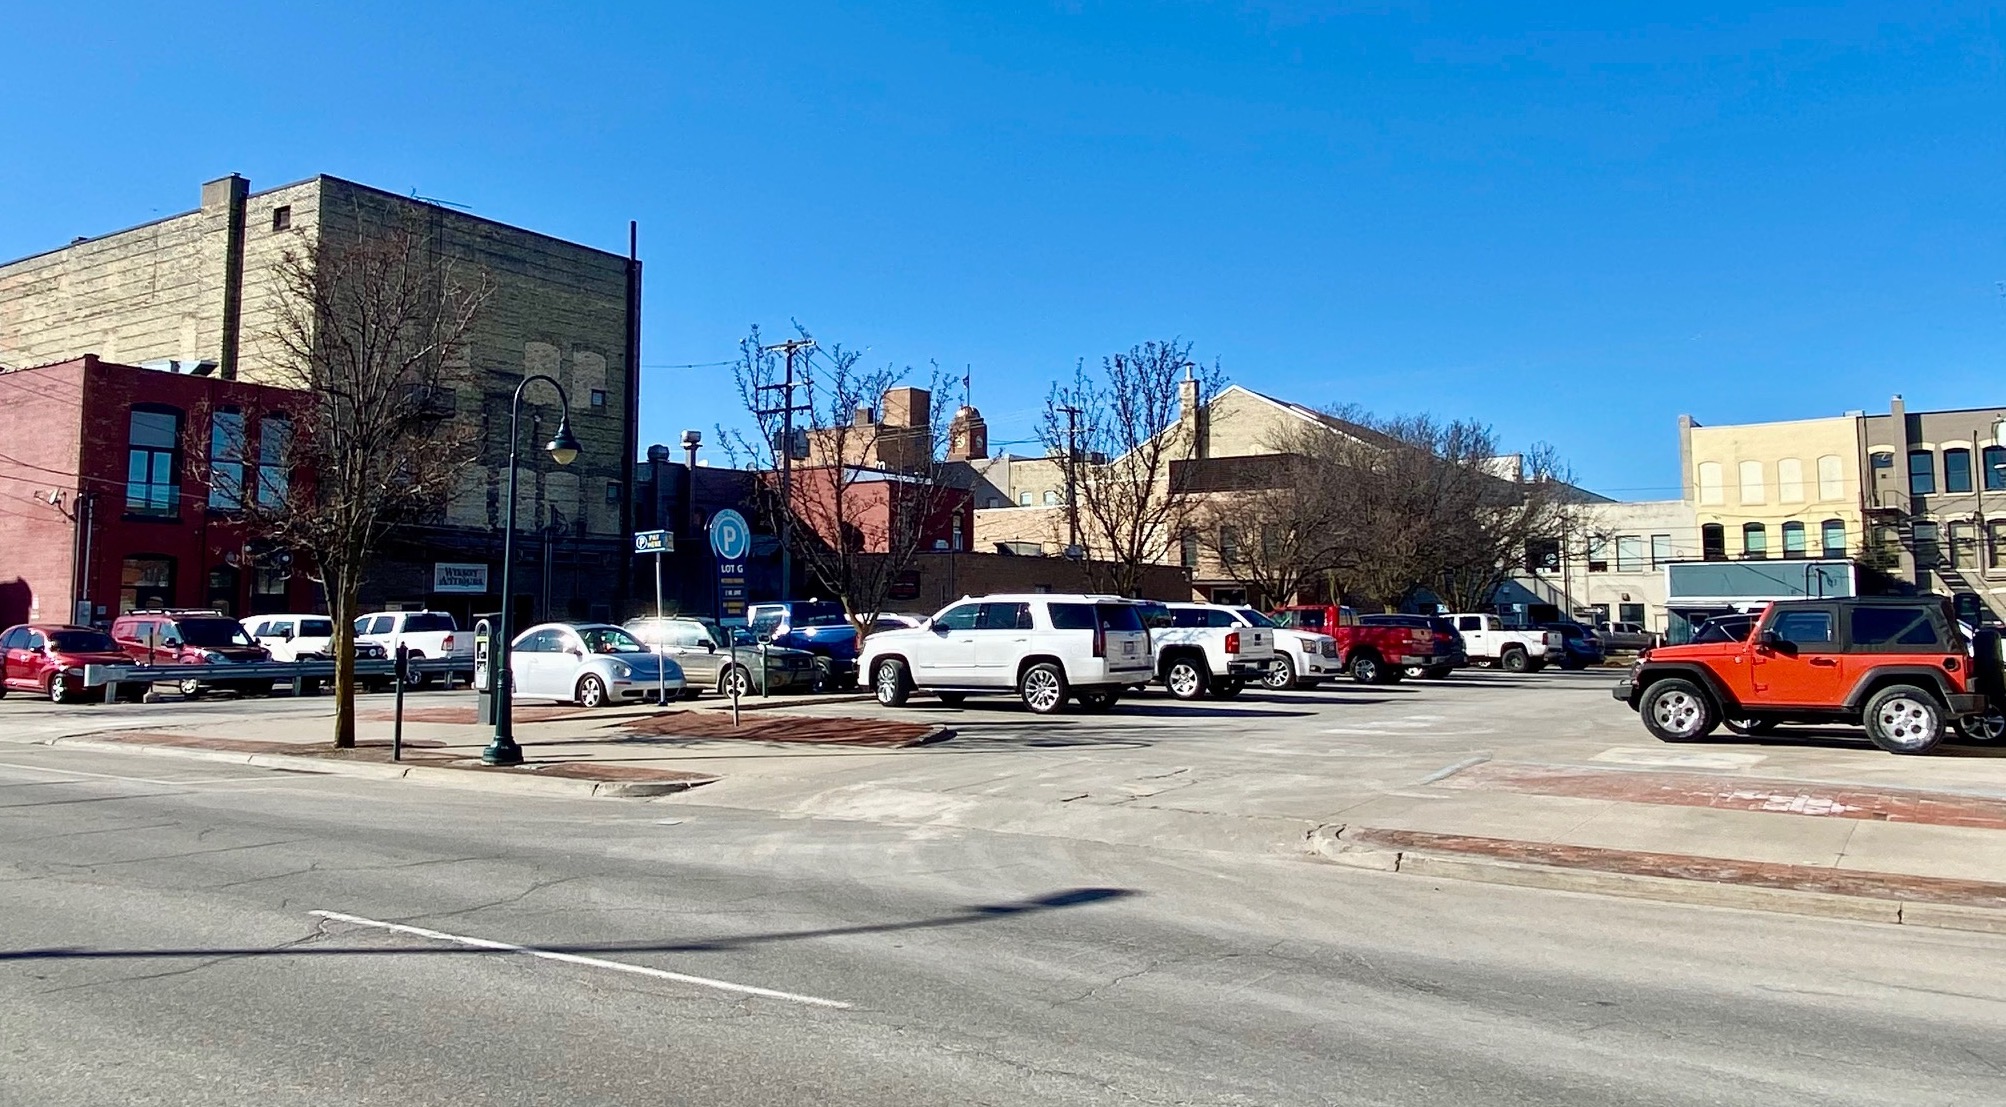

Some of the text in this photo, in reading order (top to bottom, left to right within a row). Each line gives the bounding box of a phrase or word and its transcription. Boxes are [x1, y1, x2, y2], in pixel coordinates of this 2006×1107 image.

[723, 525, 736, 551] P
[720, 564, 744, 573] LOT G
